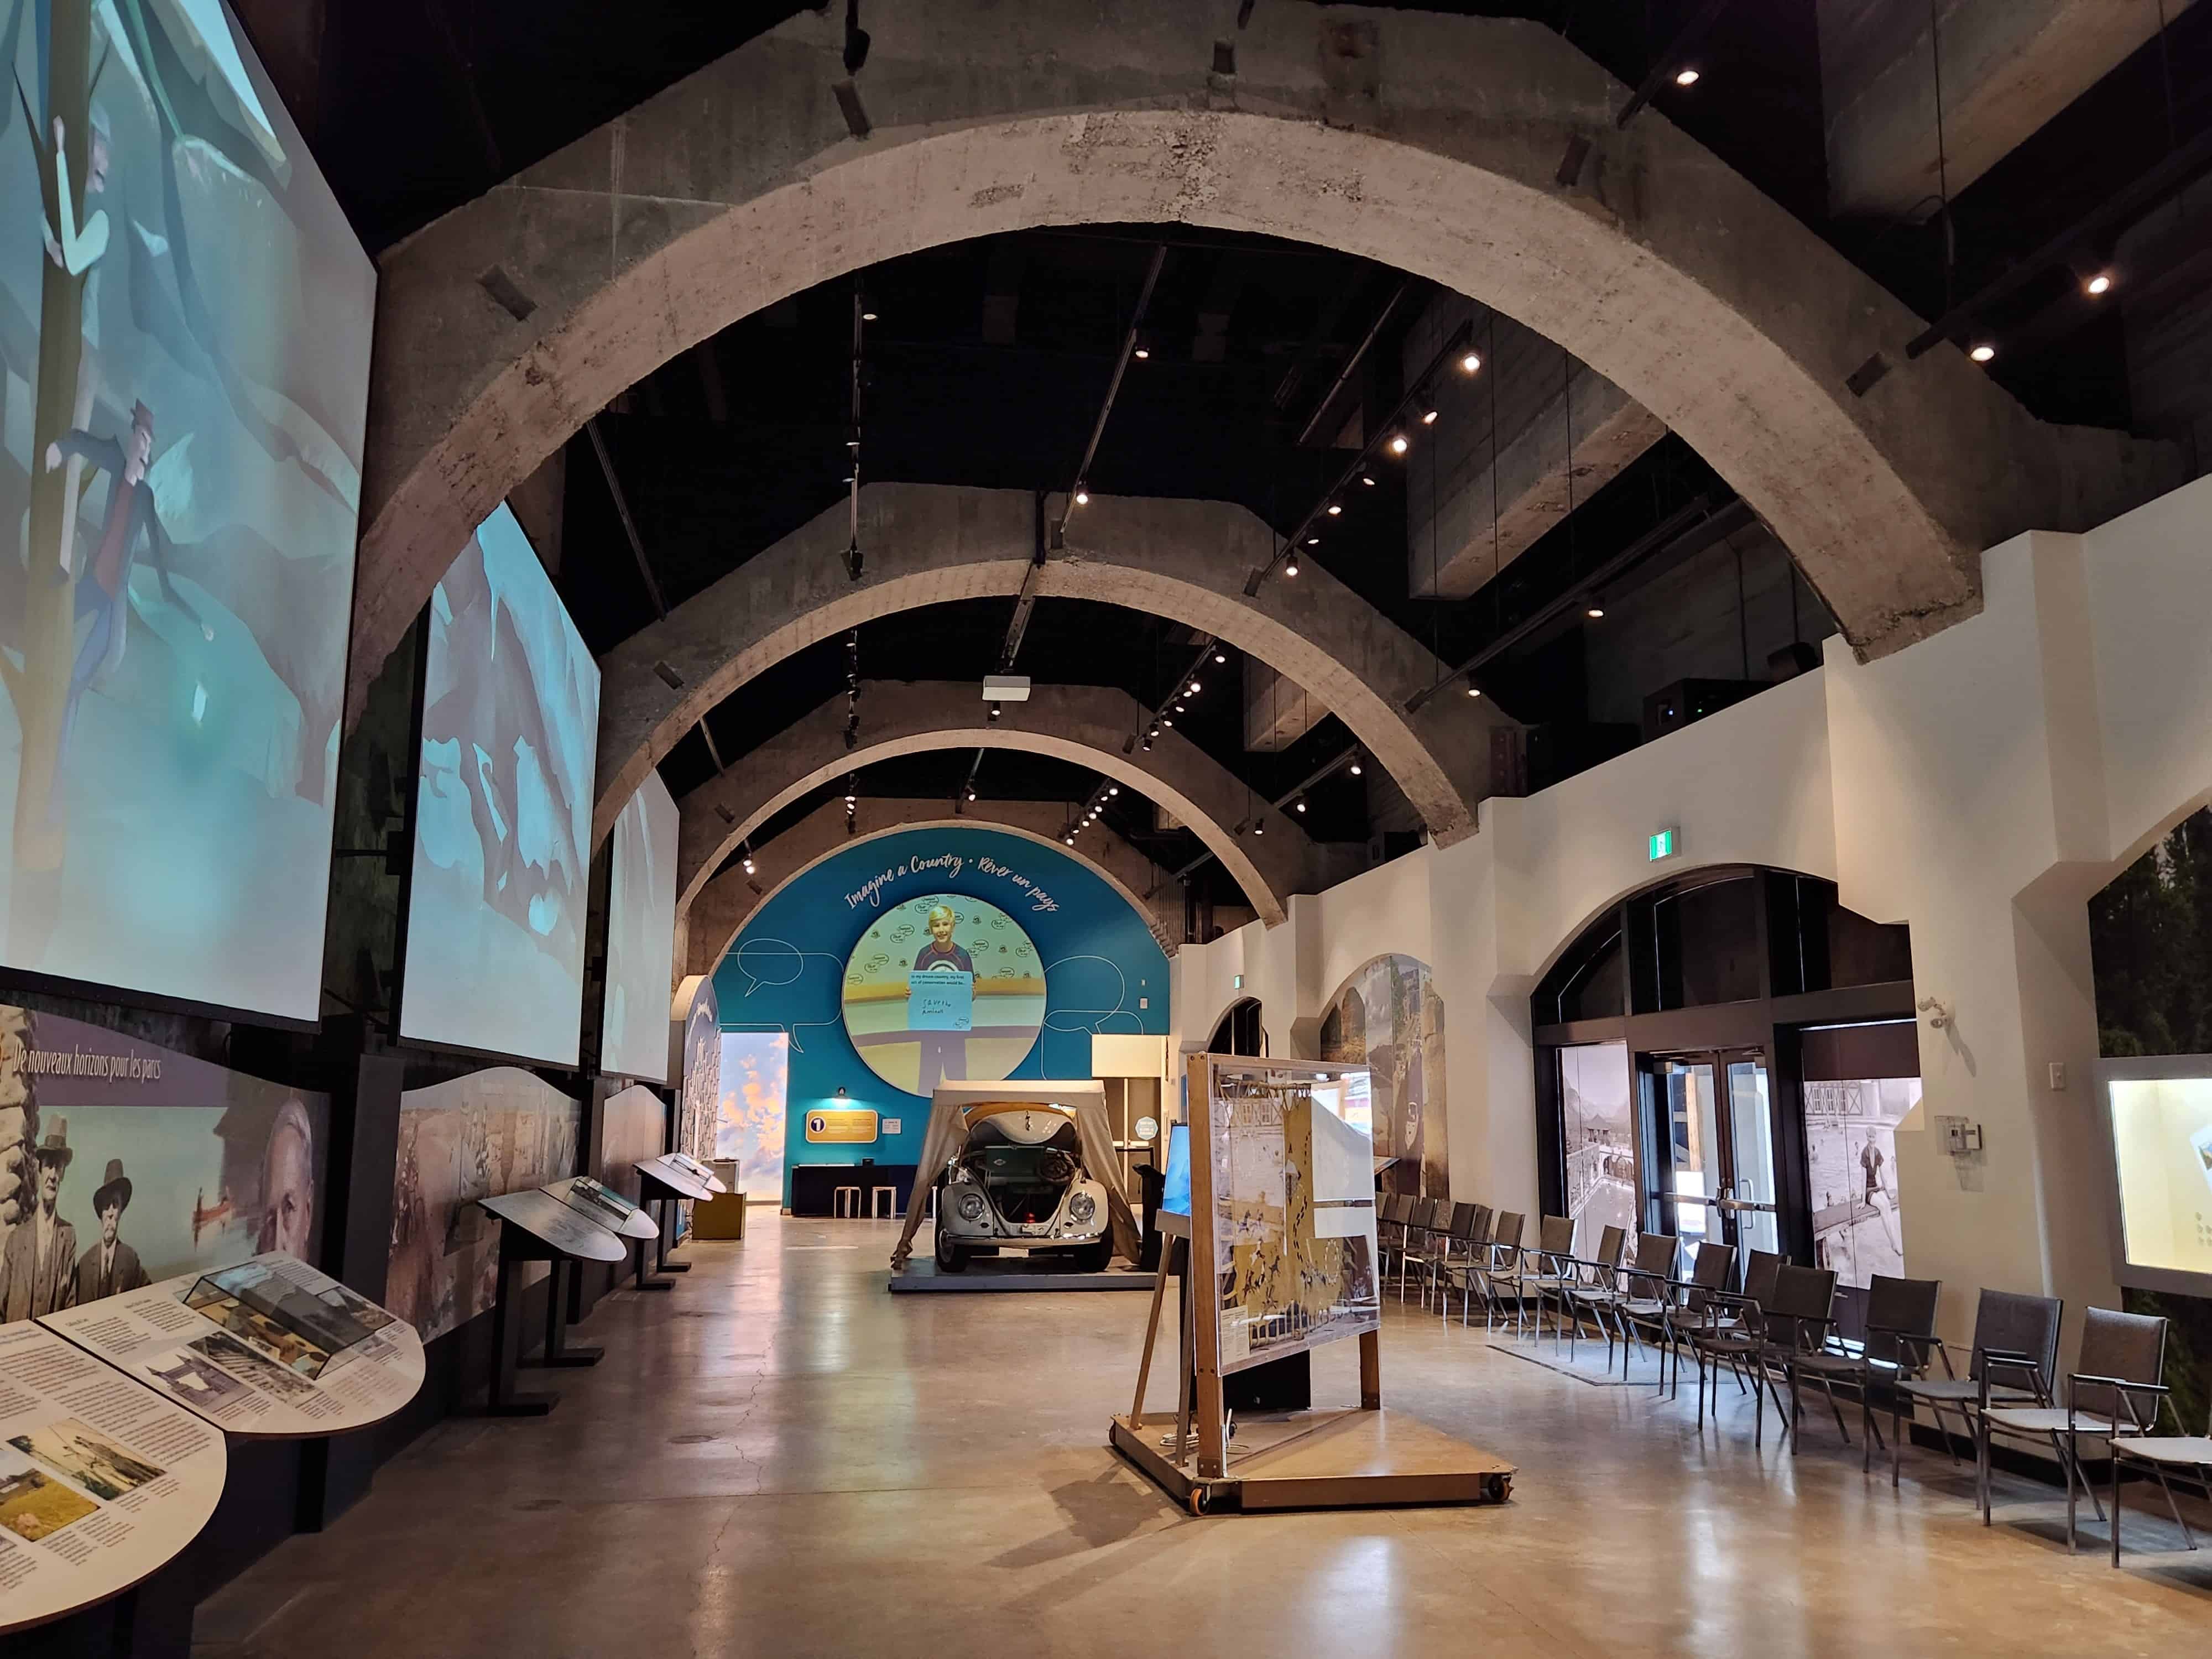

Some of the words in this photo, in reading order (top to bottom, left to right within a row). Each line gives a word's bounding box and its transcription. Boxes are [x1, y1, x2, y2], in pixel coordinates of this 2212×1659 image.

[844, 869, 894, 909] Imagine
[898, 865, 908, 877] a
[911, 853, 964, 878] Country
[1012, 874, 1031, 888] un
[1024, 886, 1060, 912] pays
[13, 1042, 27, 1072] De
[28, 1050, 74, 1075] nouveaux
[74, 1044, 108, 1077] horizons
[108, 1053, 131, 1083] pour
[130, 1048, 142, 1078] les
[142, 1057, 161, 1084] parcs
[813, 1119, 821, 1131] 1
